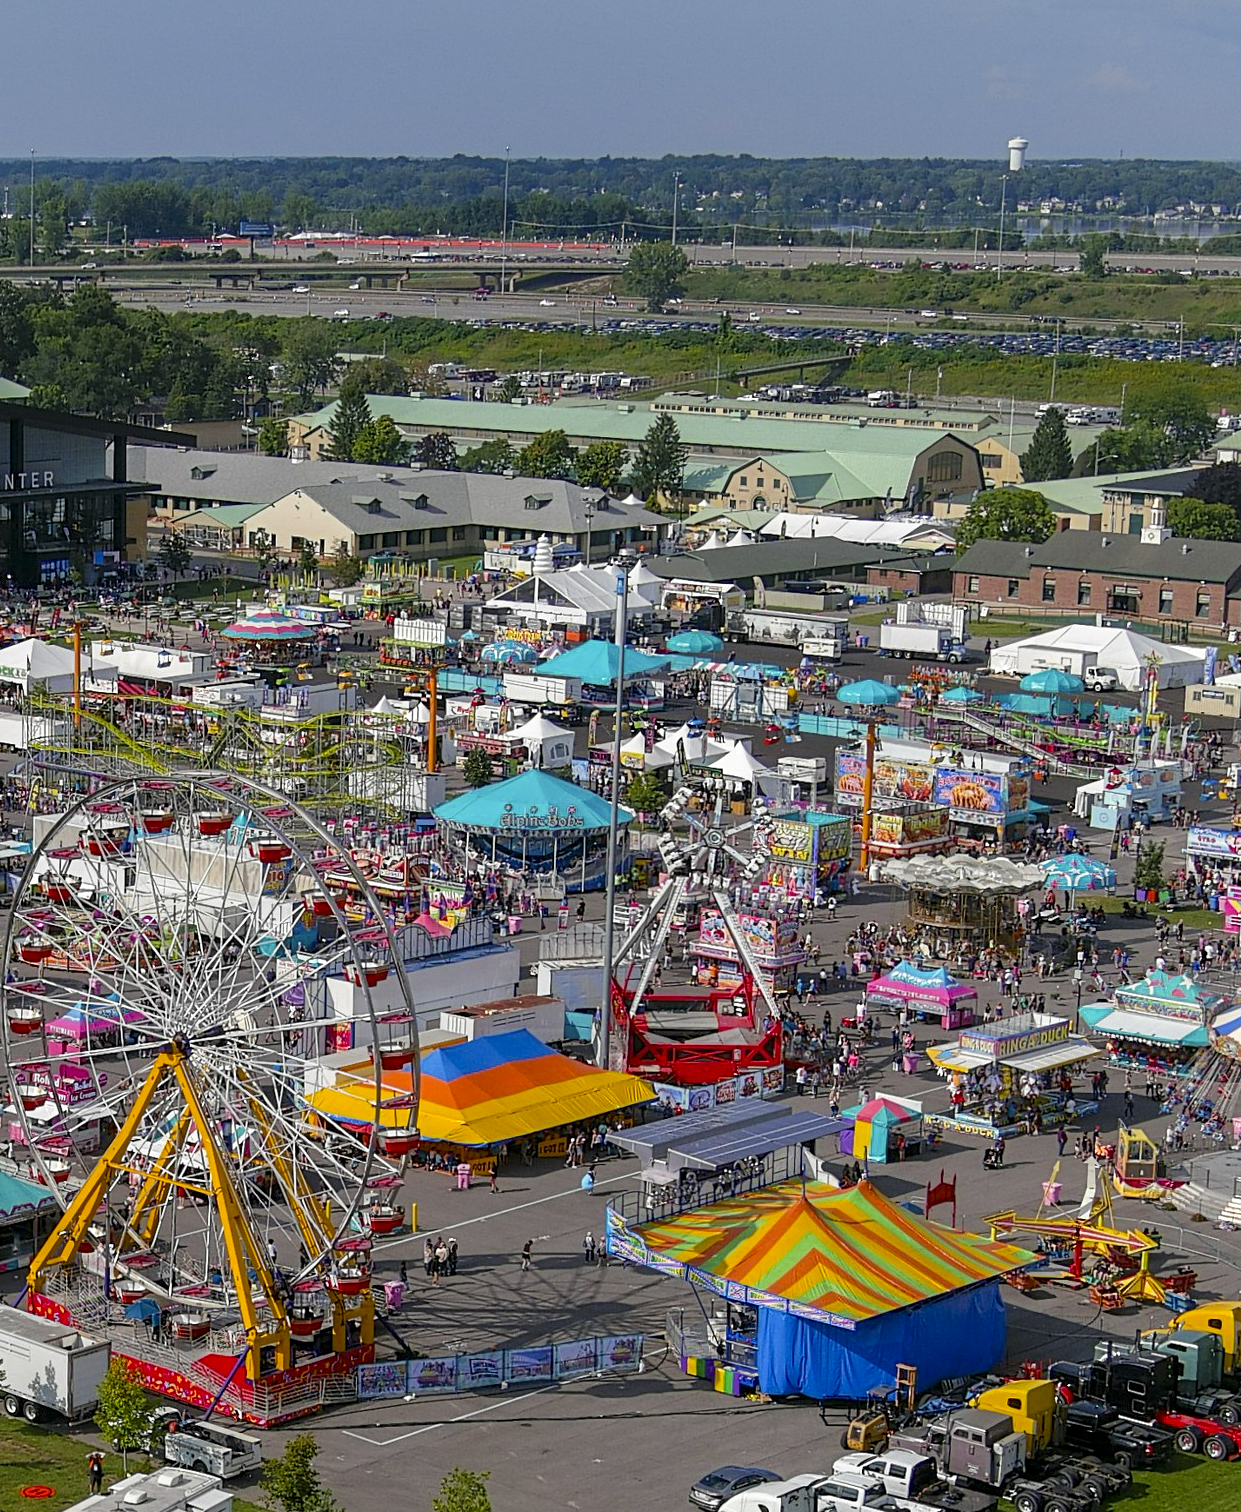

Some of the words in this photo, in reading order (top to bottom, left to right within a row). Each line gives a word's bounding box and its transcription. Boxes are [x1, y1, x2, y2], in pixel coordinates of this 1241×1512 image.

[500, 812, 547, 828] Alpine
[547, 811, 585, 828] Bobs
[771, 845, 810, 861] WIN
[999, 1035, 1025, 1056] RING
[1026, 1031, 1036, 1050] A
[1039, 1022, 1069, 1047] DUCK
[70, 1093, 79, 1103] Ice
[79, 1090, 97, 1100] Cream
[964, 1124, 995, 1138] DUCK
[543, 1144, 558, 1154] GOT
[559, 1143, 566, 1152] IT
[472, 1161, 487, 1172] GOT
